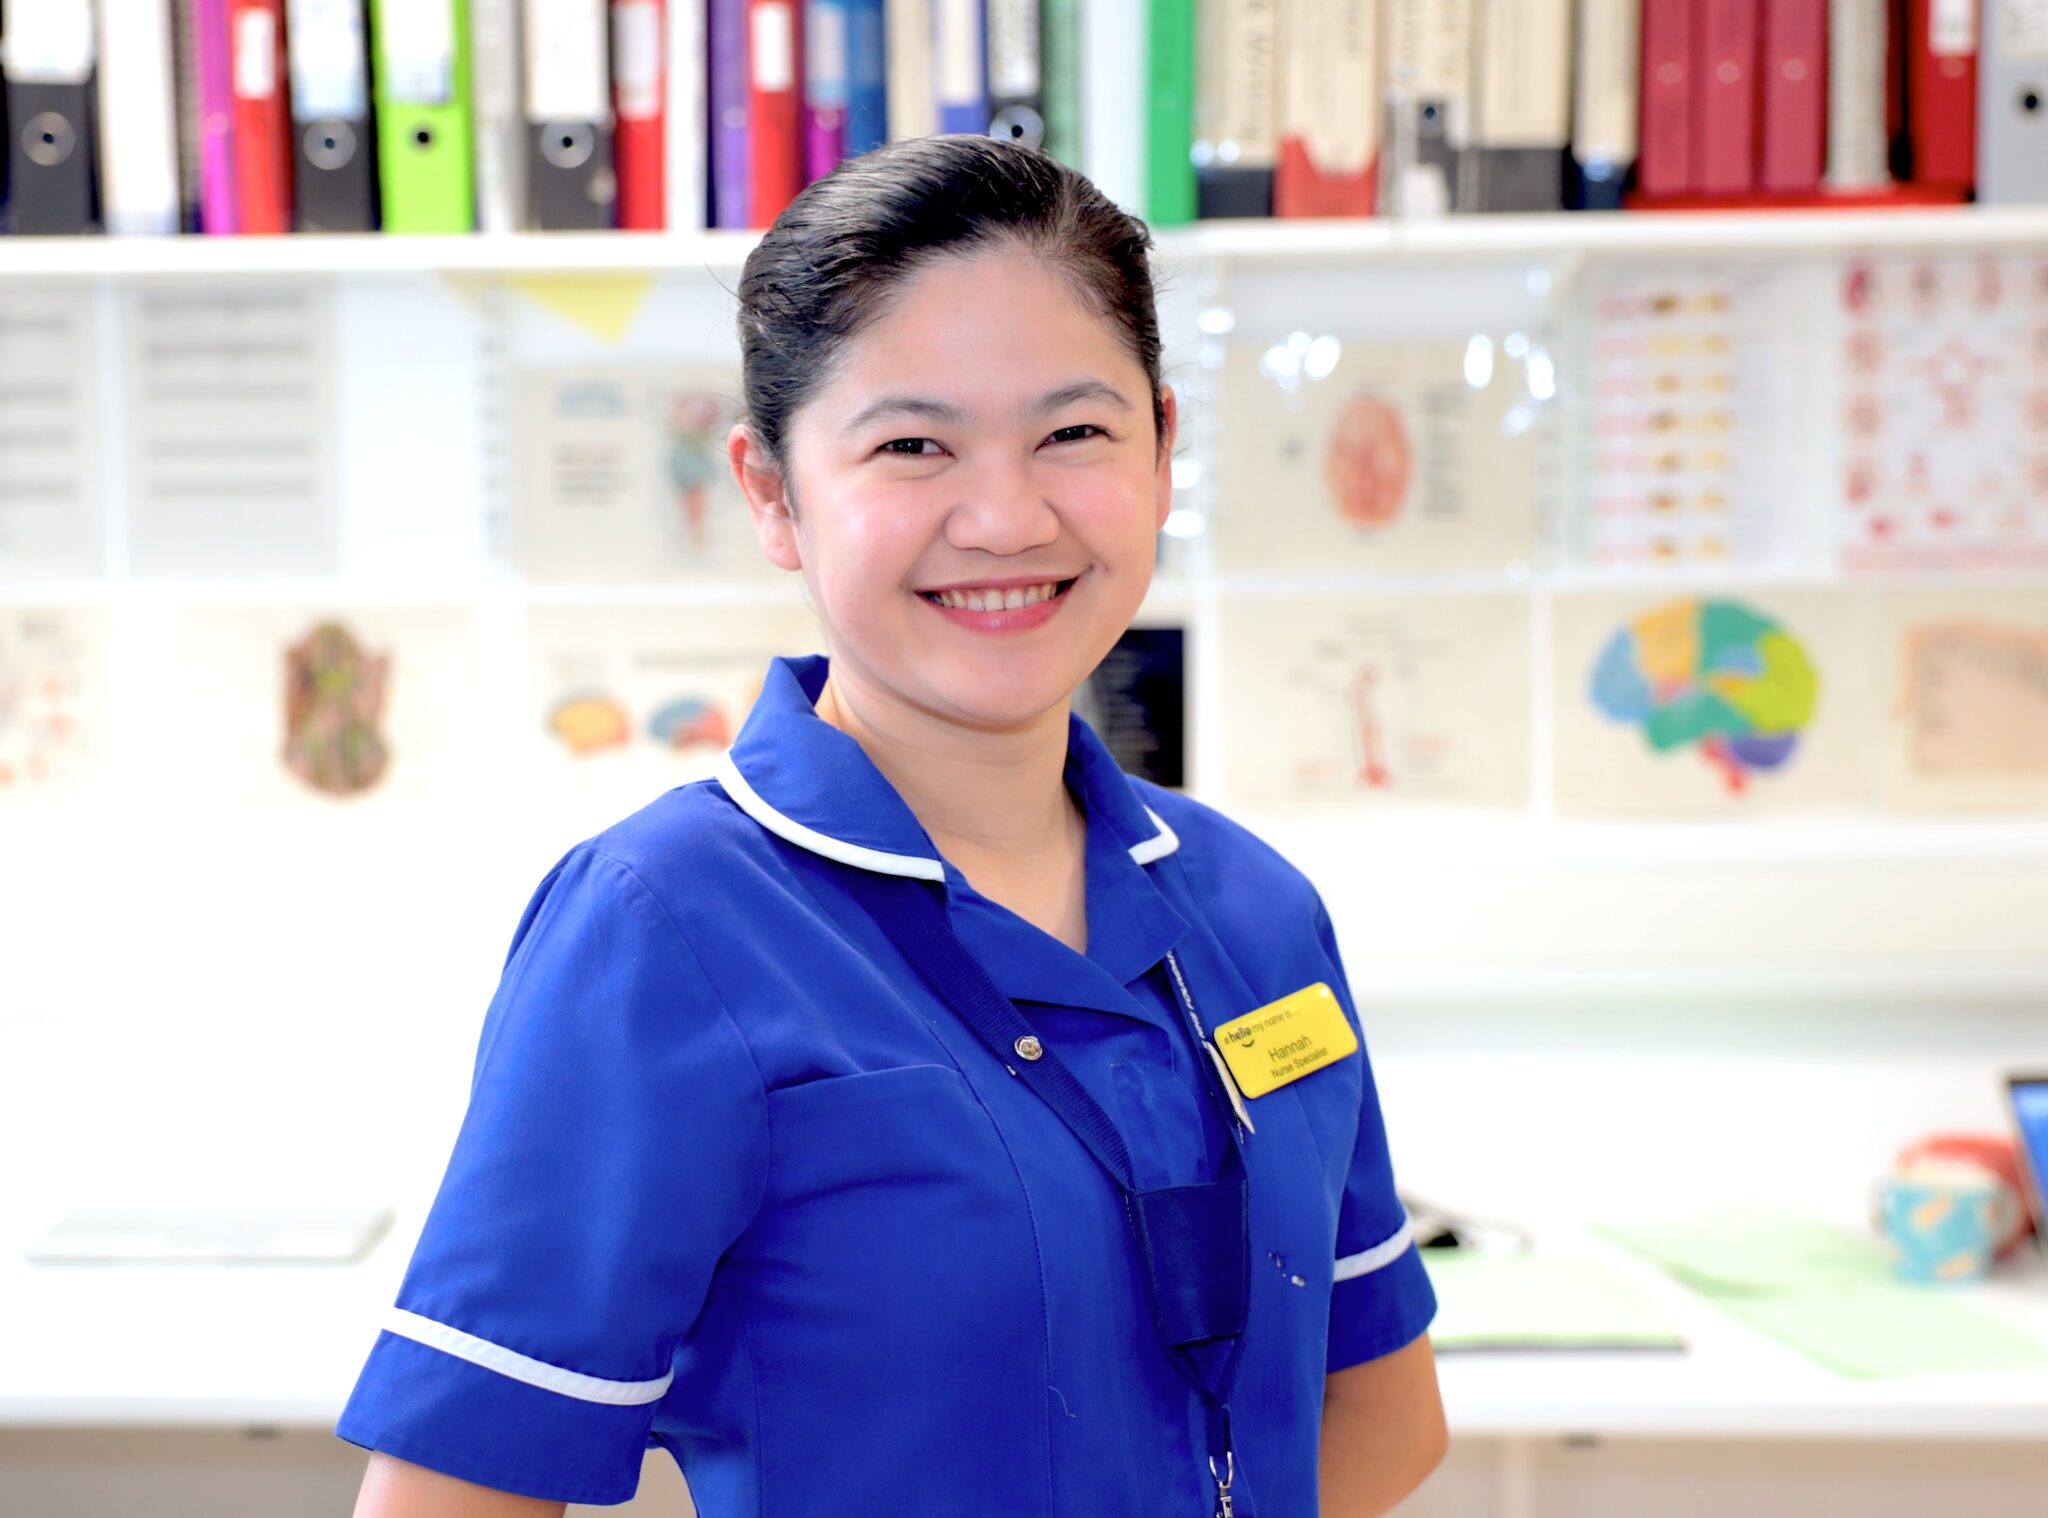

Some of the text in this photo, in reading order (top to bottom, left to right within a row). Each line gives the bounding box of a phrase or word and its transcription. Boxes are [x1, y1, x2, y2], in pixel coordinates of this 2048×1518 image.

[1252, 1023, 1264, 1034] my
[1264, 1014, 1284, 1028] name
[1268, 1034, 1312, 1063] Hannah
[1270, 1046, 1329, 1078] Nurse Specialist
